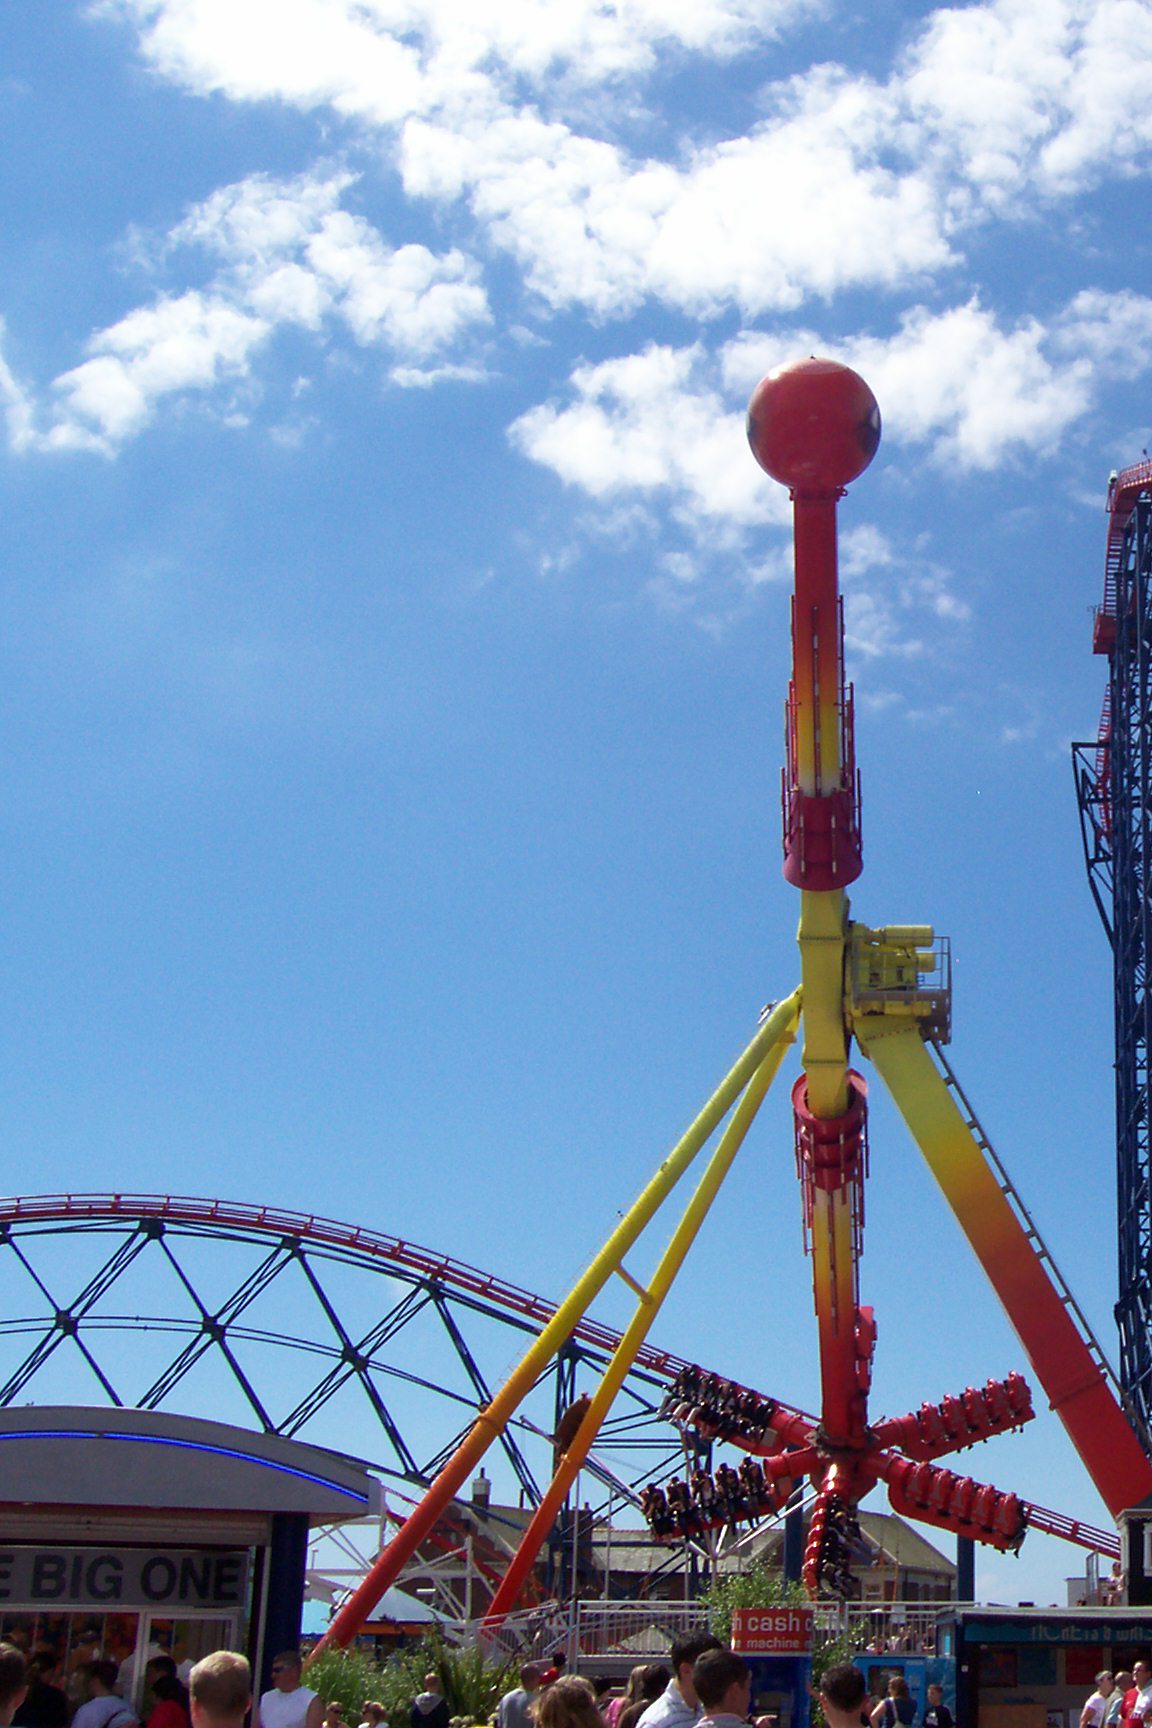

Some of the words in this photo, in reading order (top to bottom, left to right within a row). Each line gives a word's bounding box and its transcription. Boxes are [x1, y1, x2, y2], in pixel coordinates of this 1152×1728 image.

[31, 1554, 123, 1599] BIG
[140, 1556, 242, 1600] ONE
[747, 1612, 800, 1632] cash
[747, 1636, 800, 1649] machine
